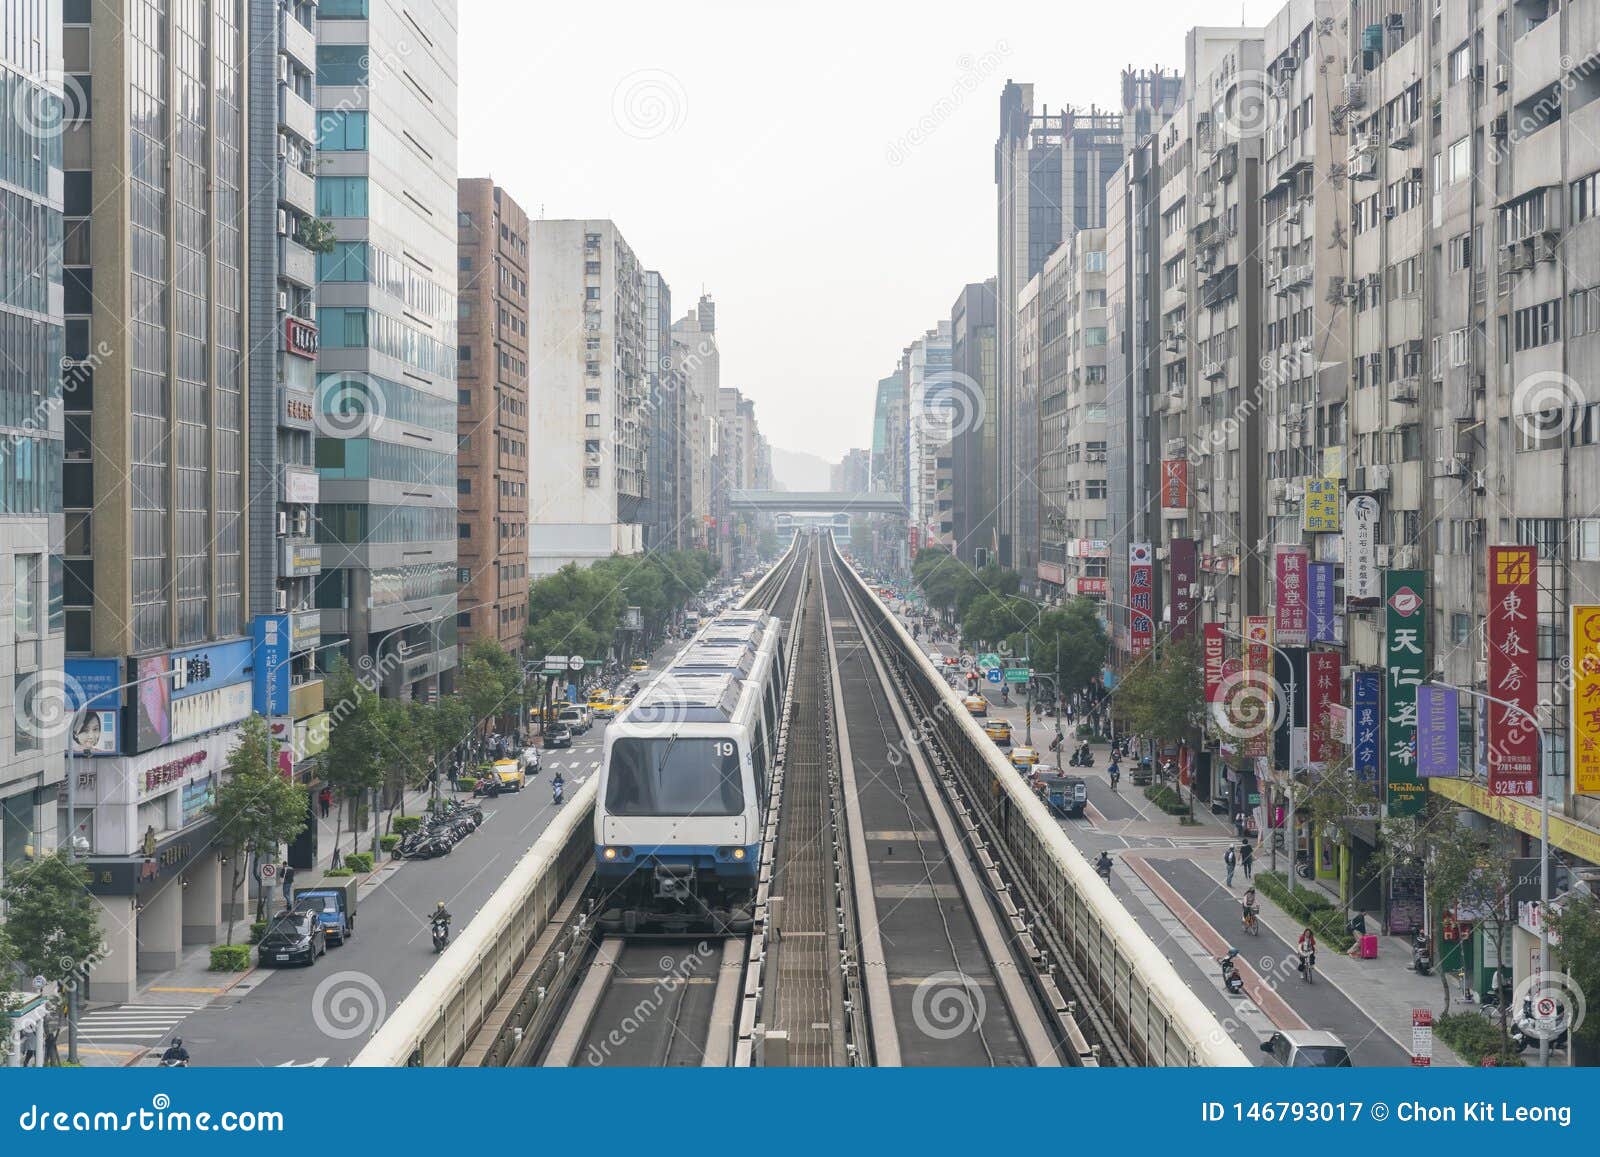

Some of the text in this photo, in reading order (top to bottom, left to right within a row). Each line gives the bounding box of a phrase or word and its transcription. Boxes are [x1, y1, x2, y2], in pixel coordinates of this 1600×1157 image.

[1132, 568, 1151, 633] 慶州館
[1206, 638, 1222, 684] EDWIN
[1499, 590, 1529, 727] 東森房屋
[1389, 627, 1424, 767] 天仁茗茶
[713, 742, 733, 756] 19
